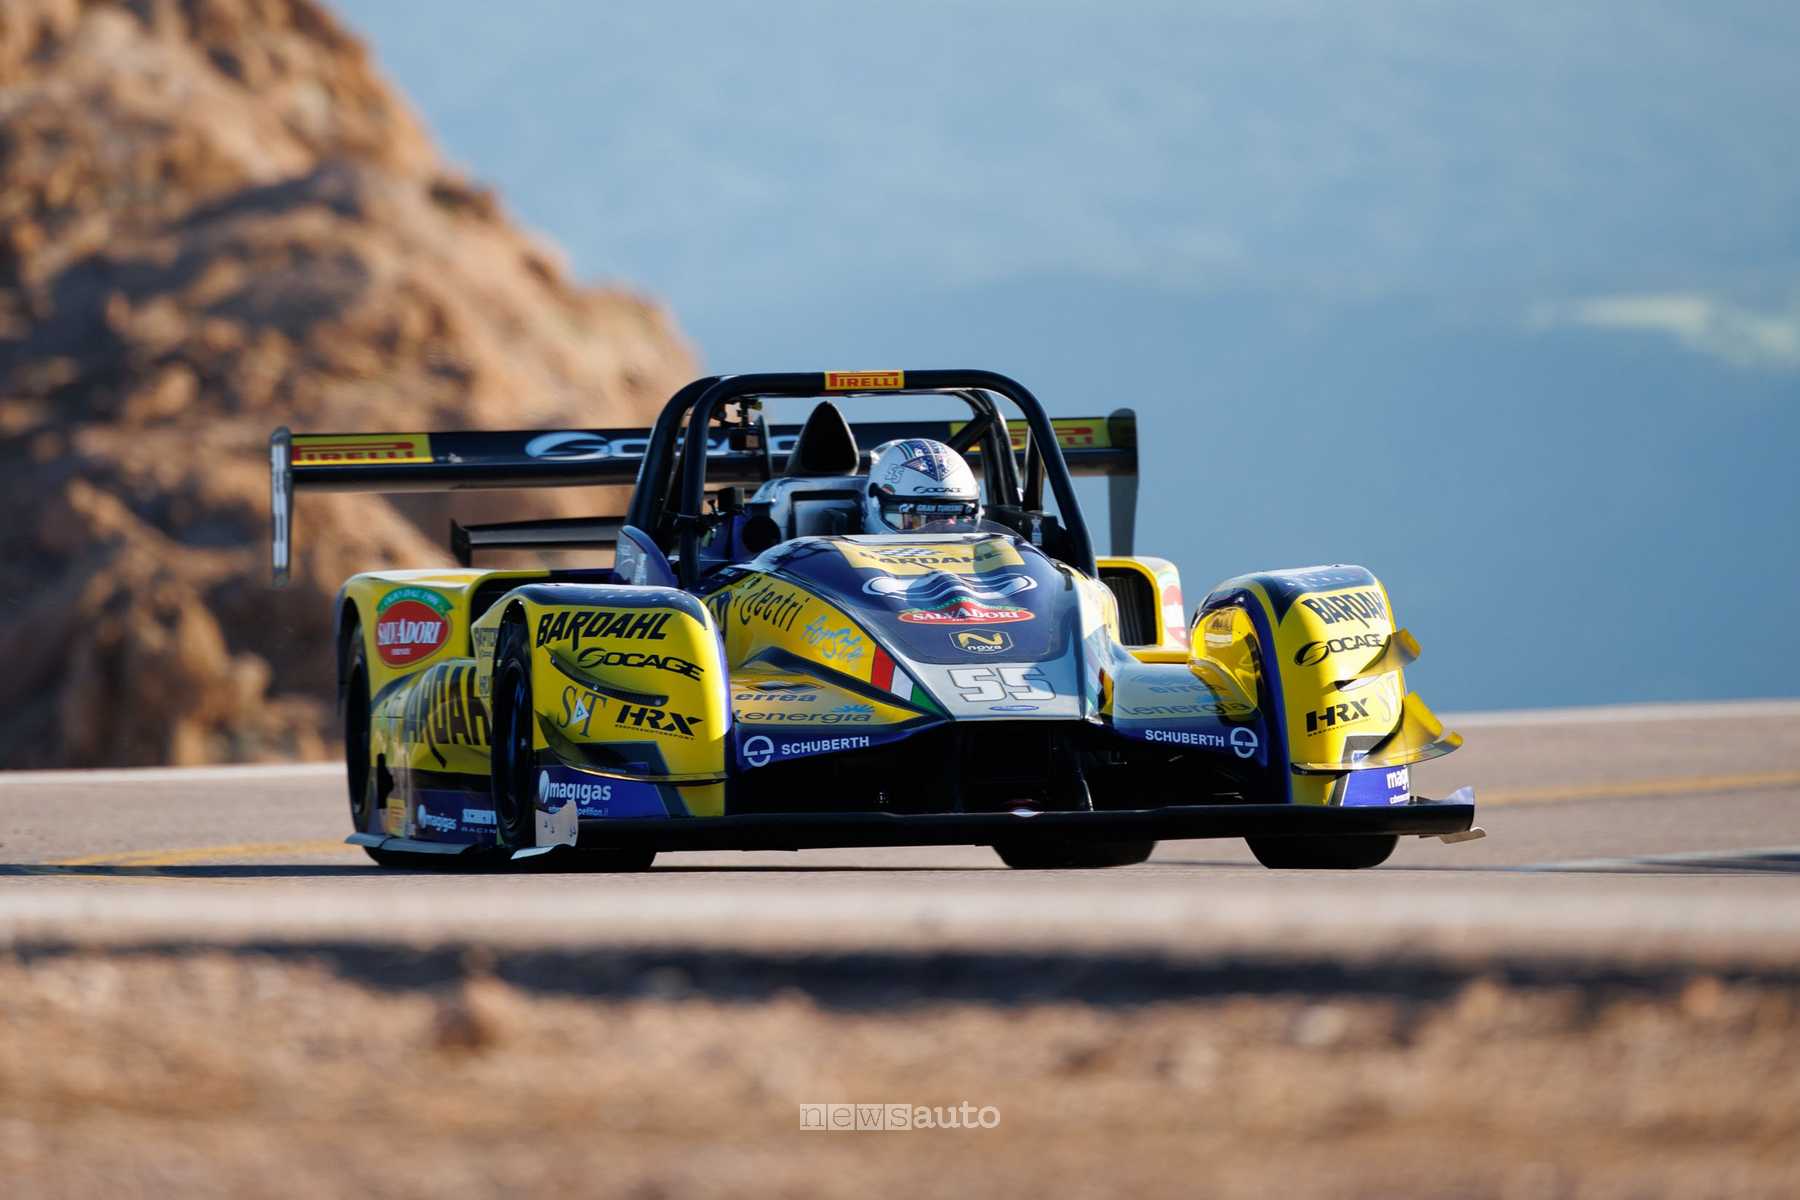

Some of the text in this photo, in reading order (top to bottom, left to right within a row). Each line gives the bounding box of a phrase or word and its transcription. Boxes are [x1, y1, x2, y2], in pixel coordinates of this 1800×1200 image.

[829, 372, 898, 387] PIRELLI
[536, 611, 673, 651] BARDAHL
[947, 667, 1057, 702] 55
[616, 705, 704, 736] HRX
[1306, 698, 1369, 732] HRX
[781, 736, 869, 755] SCHUBERTH
[1145, 729, 1224, 747] SCHUBERTH
